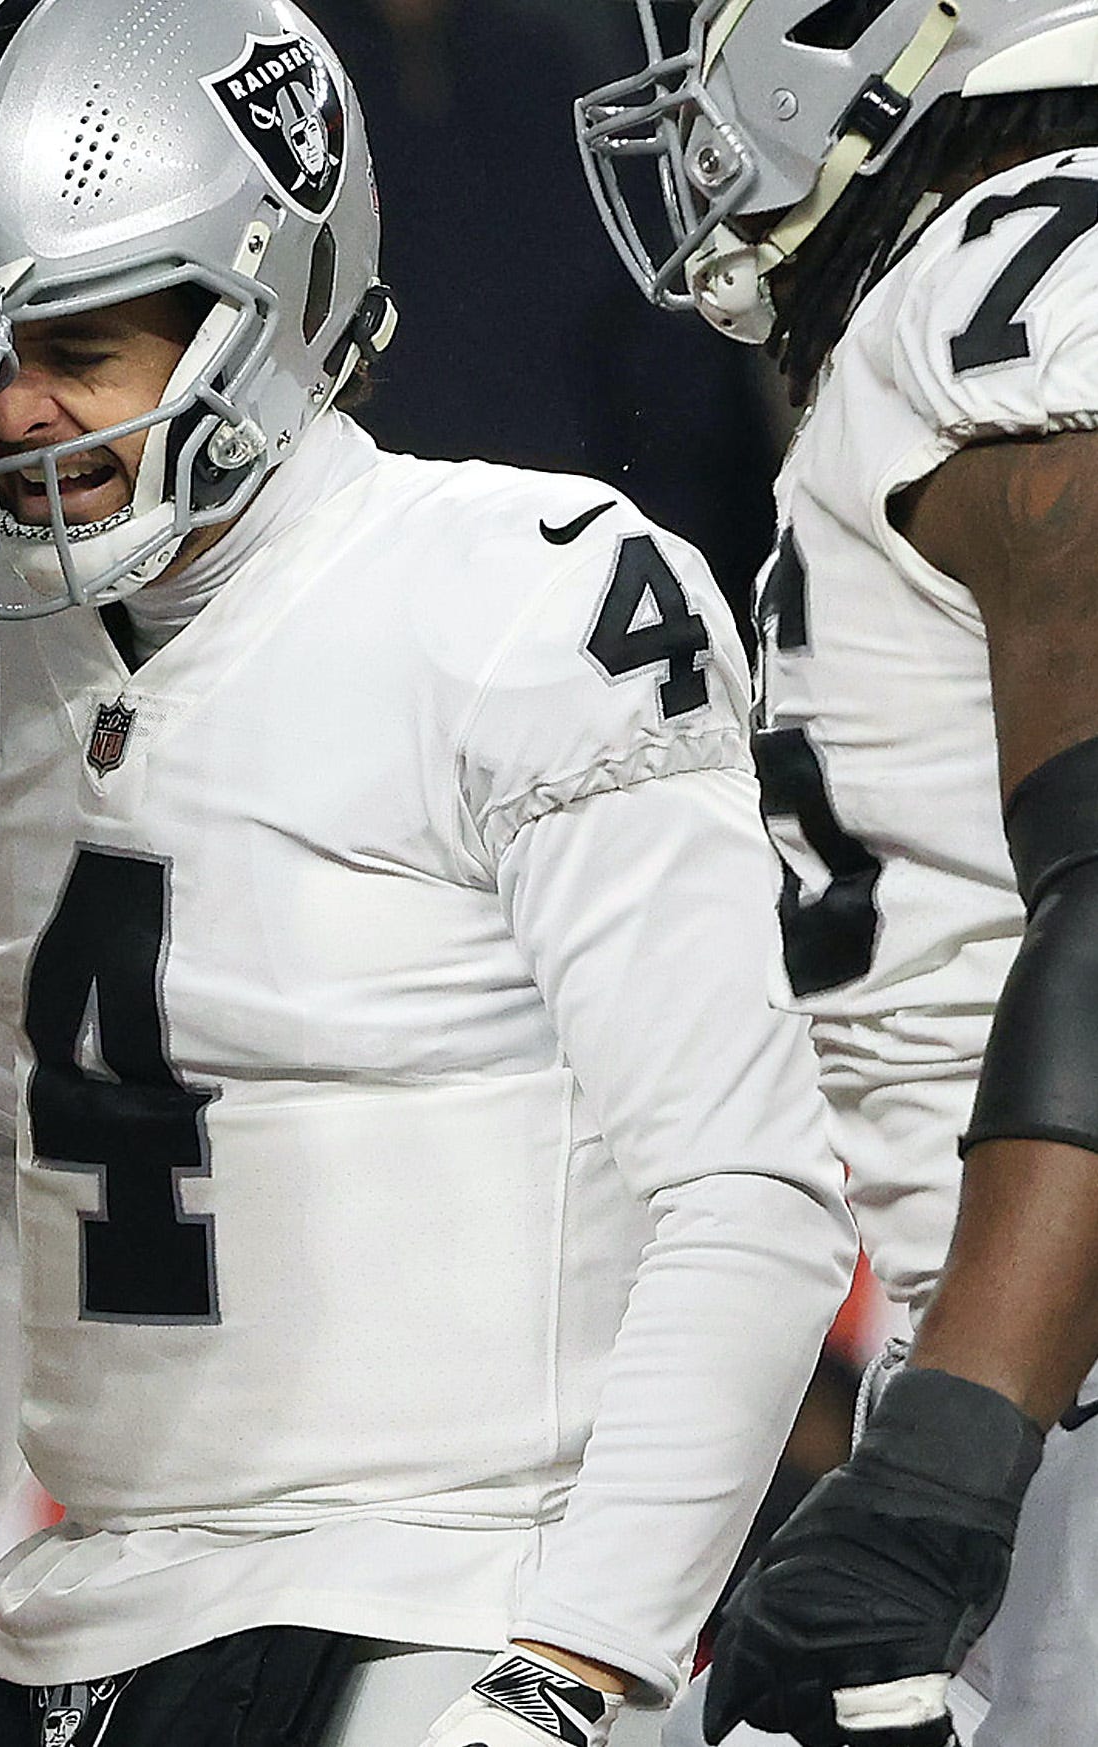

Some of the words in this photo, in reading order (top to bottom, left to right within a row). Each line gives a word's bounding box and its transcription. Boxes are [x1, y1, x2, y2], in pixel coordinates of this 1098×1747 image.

[227, 39, 314, 100] RAIDERS
[949, 174, 1098, 375] 7
[580, 532, 714, 720] 4
[20, 843, 221, 1324] 4
